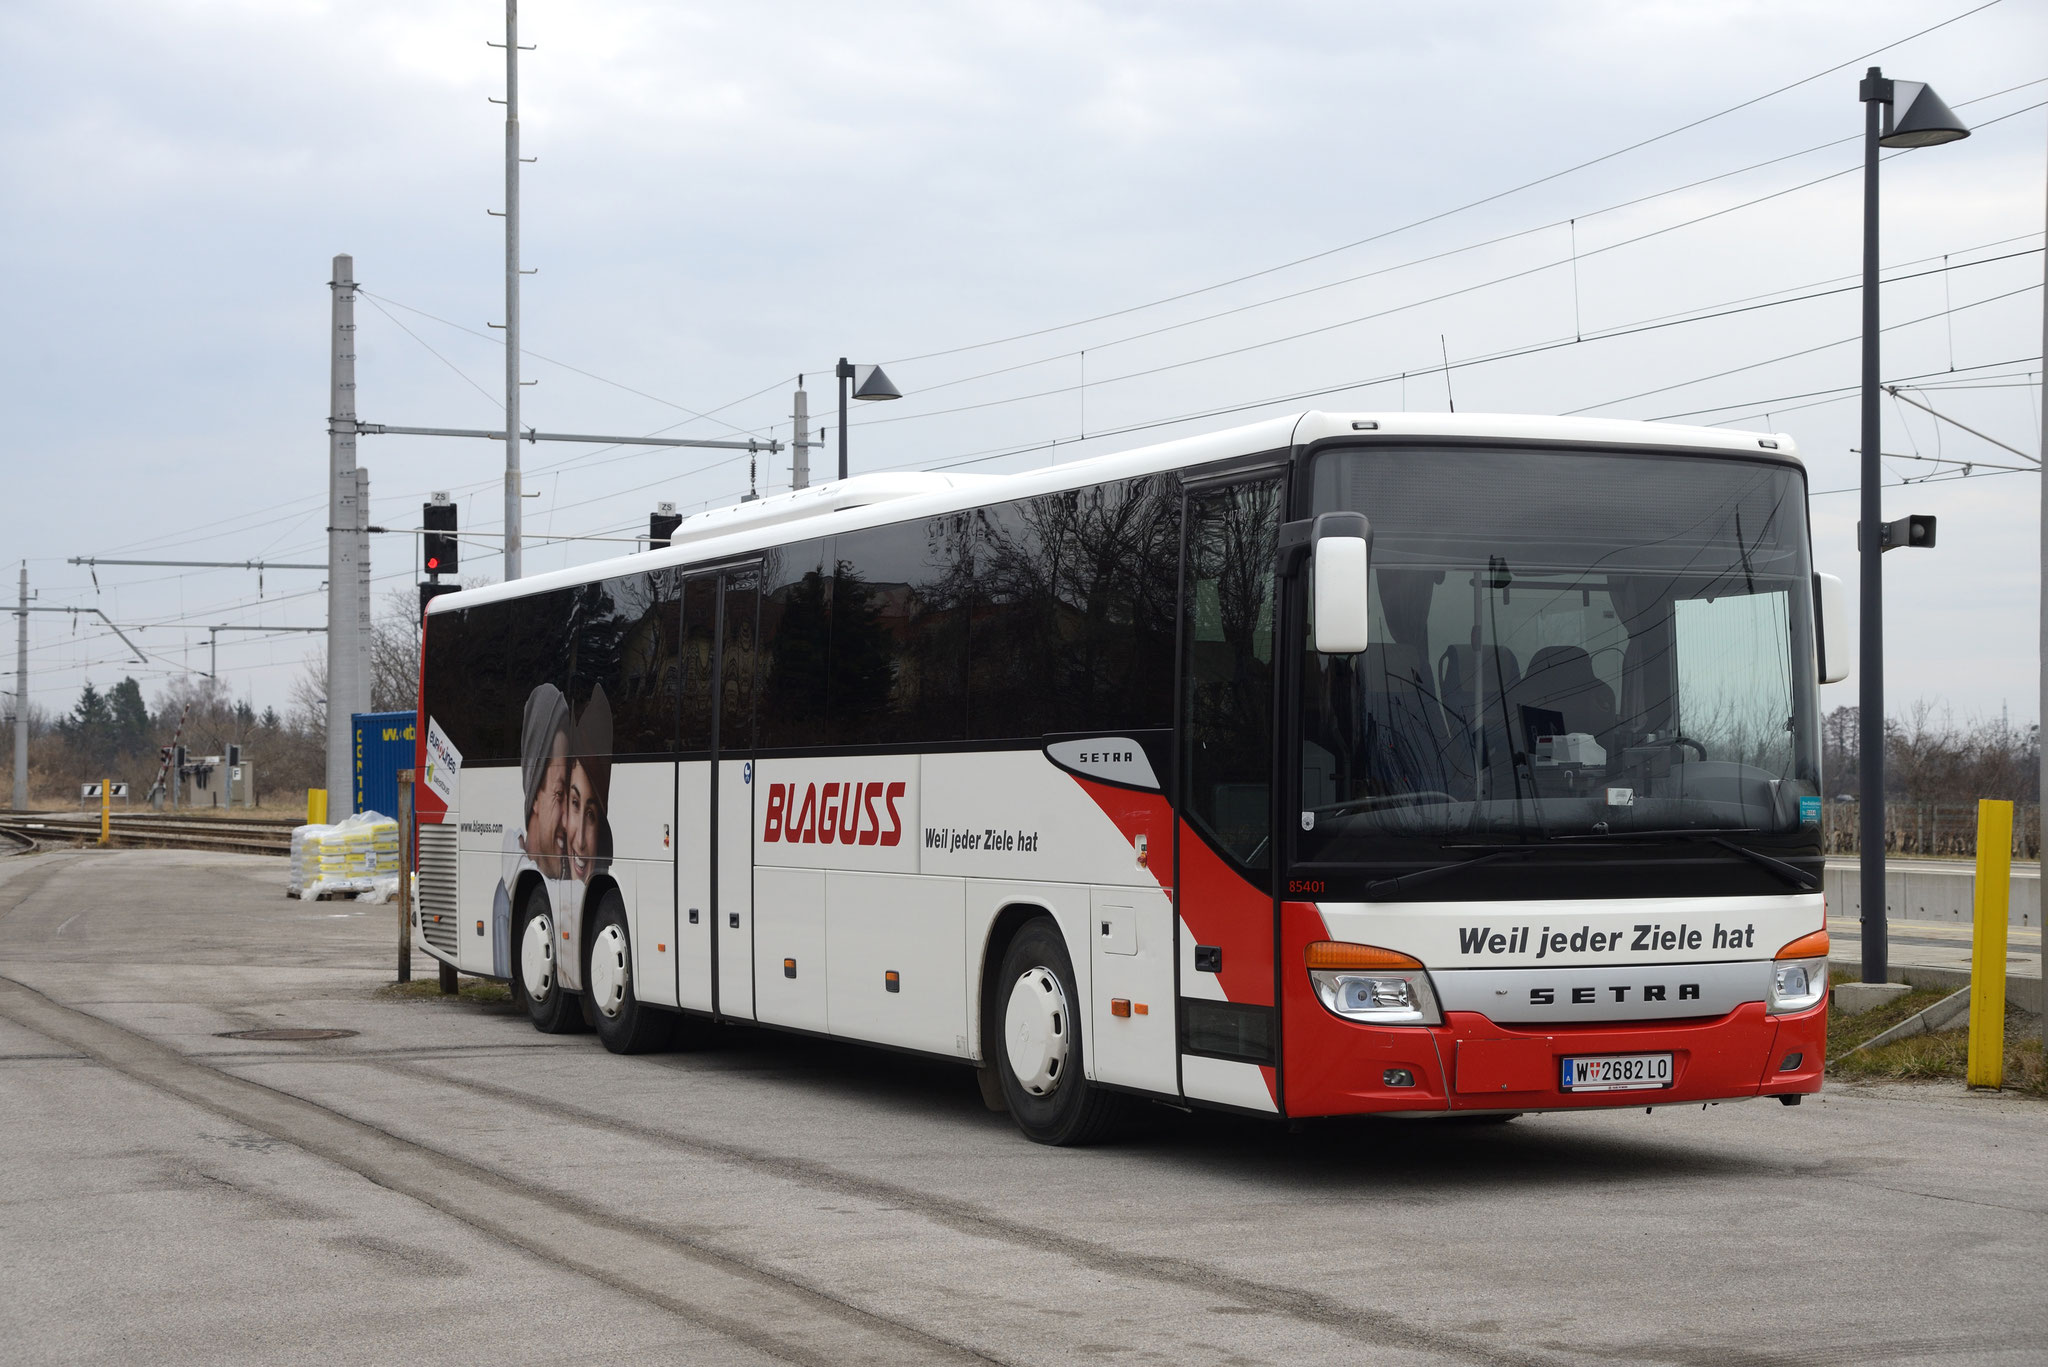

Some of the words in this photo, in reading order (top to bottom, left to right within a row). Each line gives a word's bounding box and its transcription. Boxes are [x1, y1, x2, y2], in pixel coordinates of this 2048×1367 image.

[1079, 752, 1133, 763] SETRA
[763, 782, 906, 847] BLAGUSS
[460, 819, 503, 836] www.blaguss.com
[925, 828, 948, 849] Weil
[950, 828, 981, 853] jeder
[983, 829, 1013, 851] Ziele
[1017, 830, 1038, 852] hat
[1288, 880, 1325, 894] 85401
[1458, 926, 1529, 955] Weil
[1535, 925, 1623, 959] jeder
[1630, 923, 1703, 951] Ziele
[1712, 923, 1755, 949] hat
[1529, 983, 1700, 1005] SETRA
